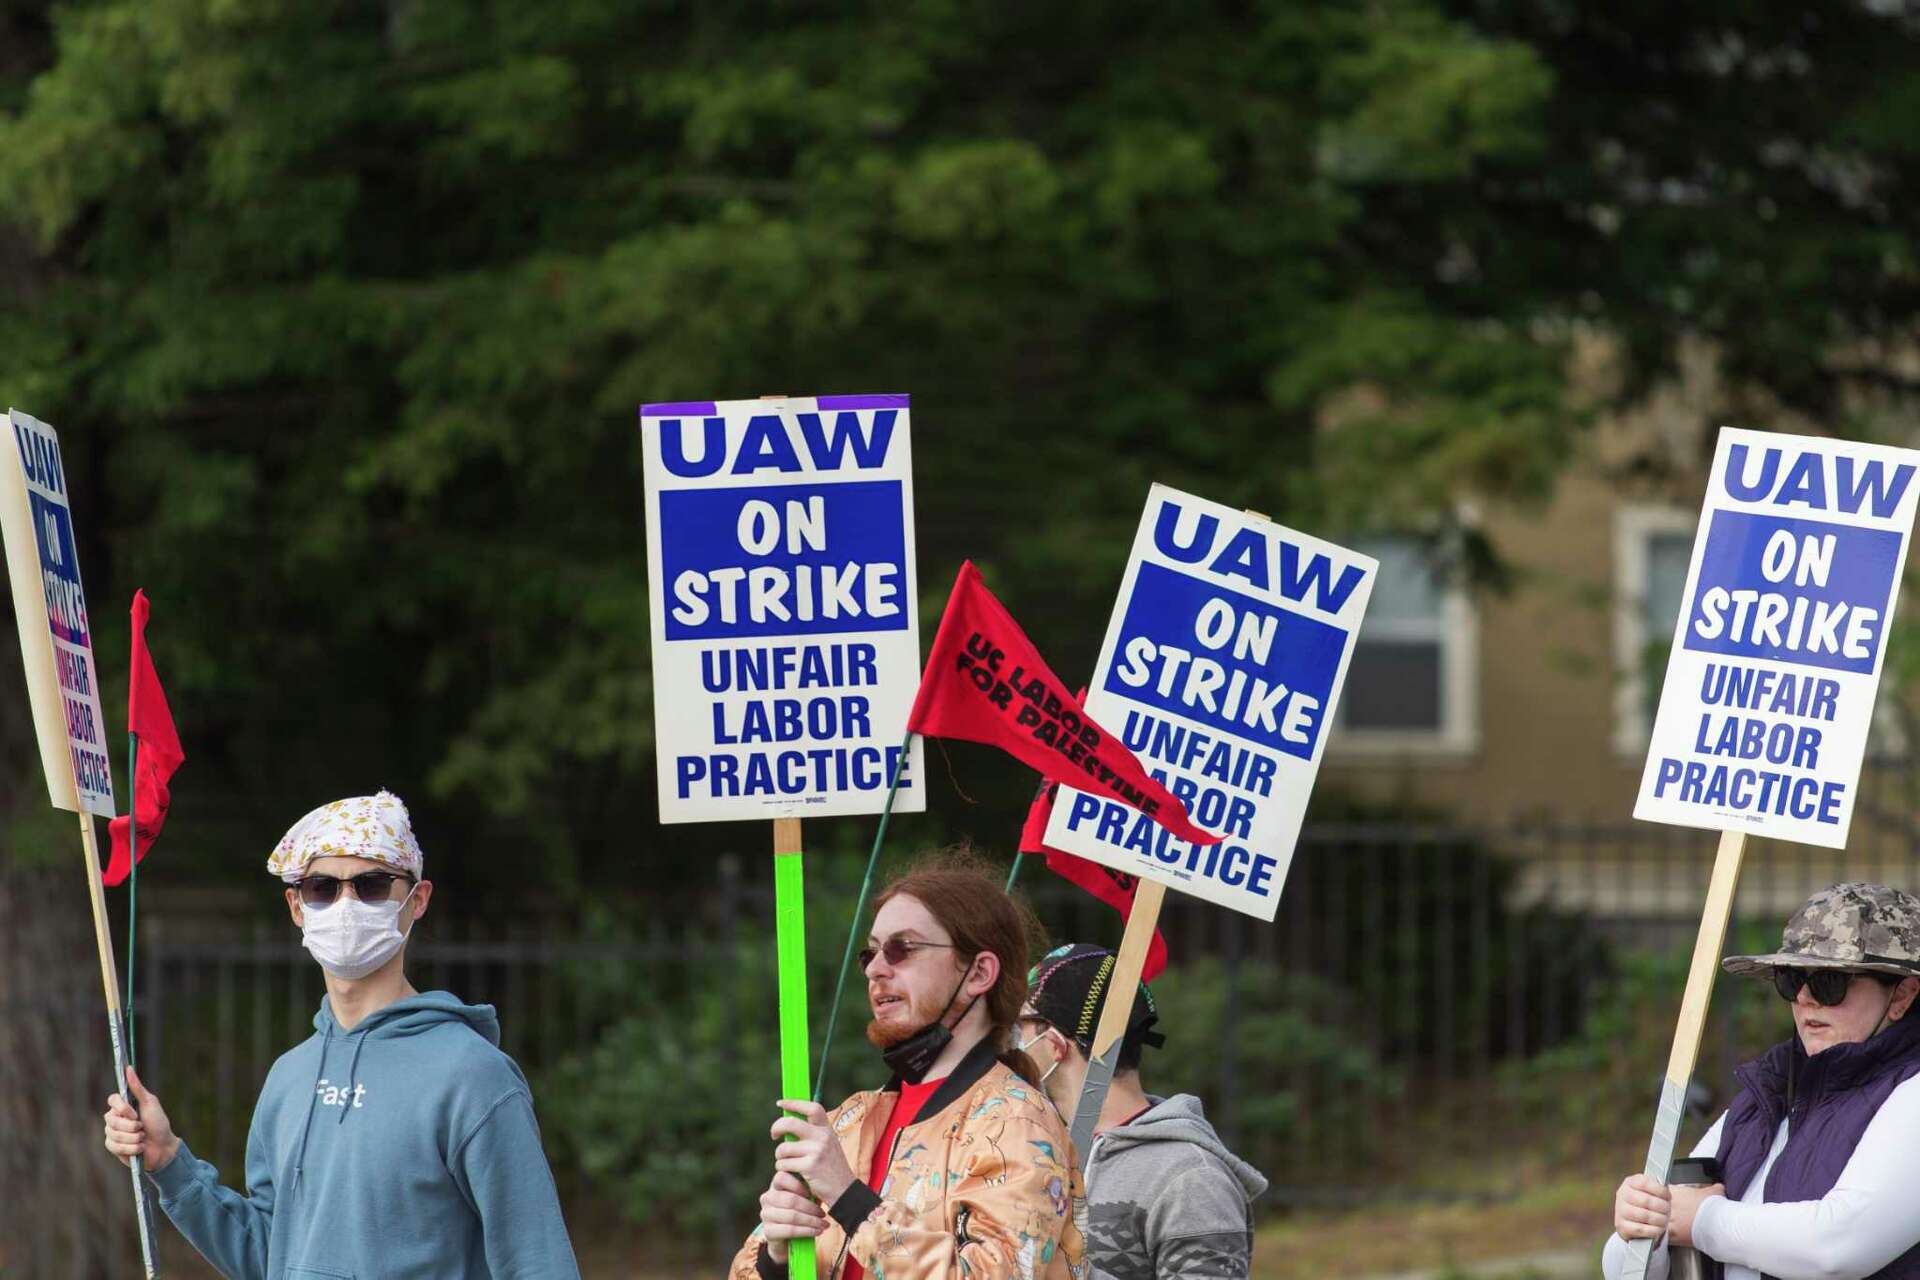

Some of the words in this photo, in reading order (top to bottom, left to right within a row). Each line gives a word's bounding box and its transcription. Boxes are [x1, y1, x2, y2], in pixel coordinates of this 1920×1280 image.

[15, 424, 63, 495] UAW
[659, 410, 898, 478] UAW
[1724, 444, 1917, 519] UAW
[44, 509, 63, 566] ON
[737, 495, 826, 556] ON
[1153, 501, 1367, 615] UAW
[1761, 529, 1837, 588] ON
[44, 570, 86, 634] STRIKE
[671, 561, 900, 626] STRIKE
[1694, 586, 1878, 659] STRIKE
[1195, 597, 1279, 667] ON
[56, 645, 91, 696] UNFAIR
[701, 643, 878, 693] UNFAIR
[957, 652, 1014, 712] FOR
[967, 632, 1005, 671] UC
[1009, 666, 1101, 753] LABOR
[1117, 636, 1320, 745] STRIKE
[1701, 663, 1841, 722] UNFAIR
[712, 696, 871, 744] LABOR
[1695, 713, 1822, 770] LABOR
[70, 744, 110, 795] ACTICE
[677, 746, 912, 799] PRACTICE
[1122, 710, 1277, 797] UNFAIR
[1149, 767, 1256, 841] BOR
[1653, 758, 1845, 825] PRACTICE
